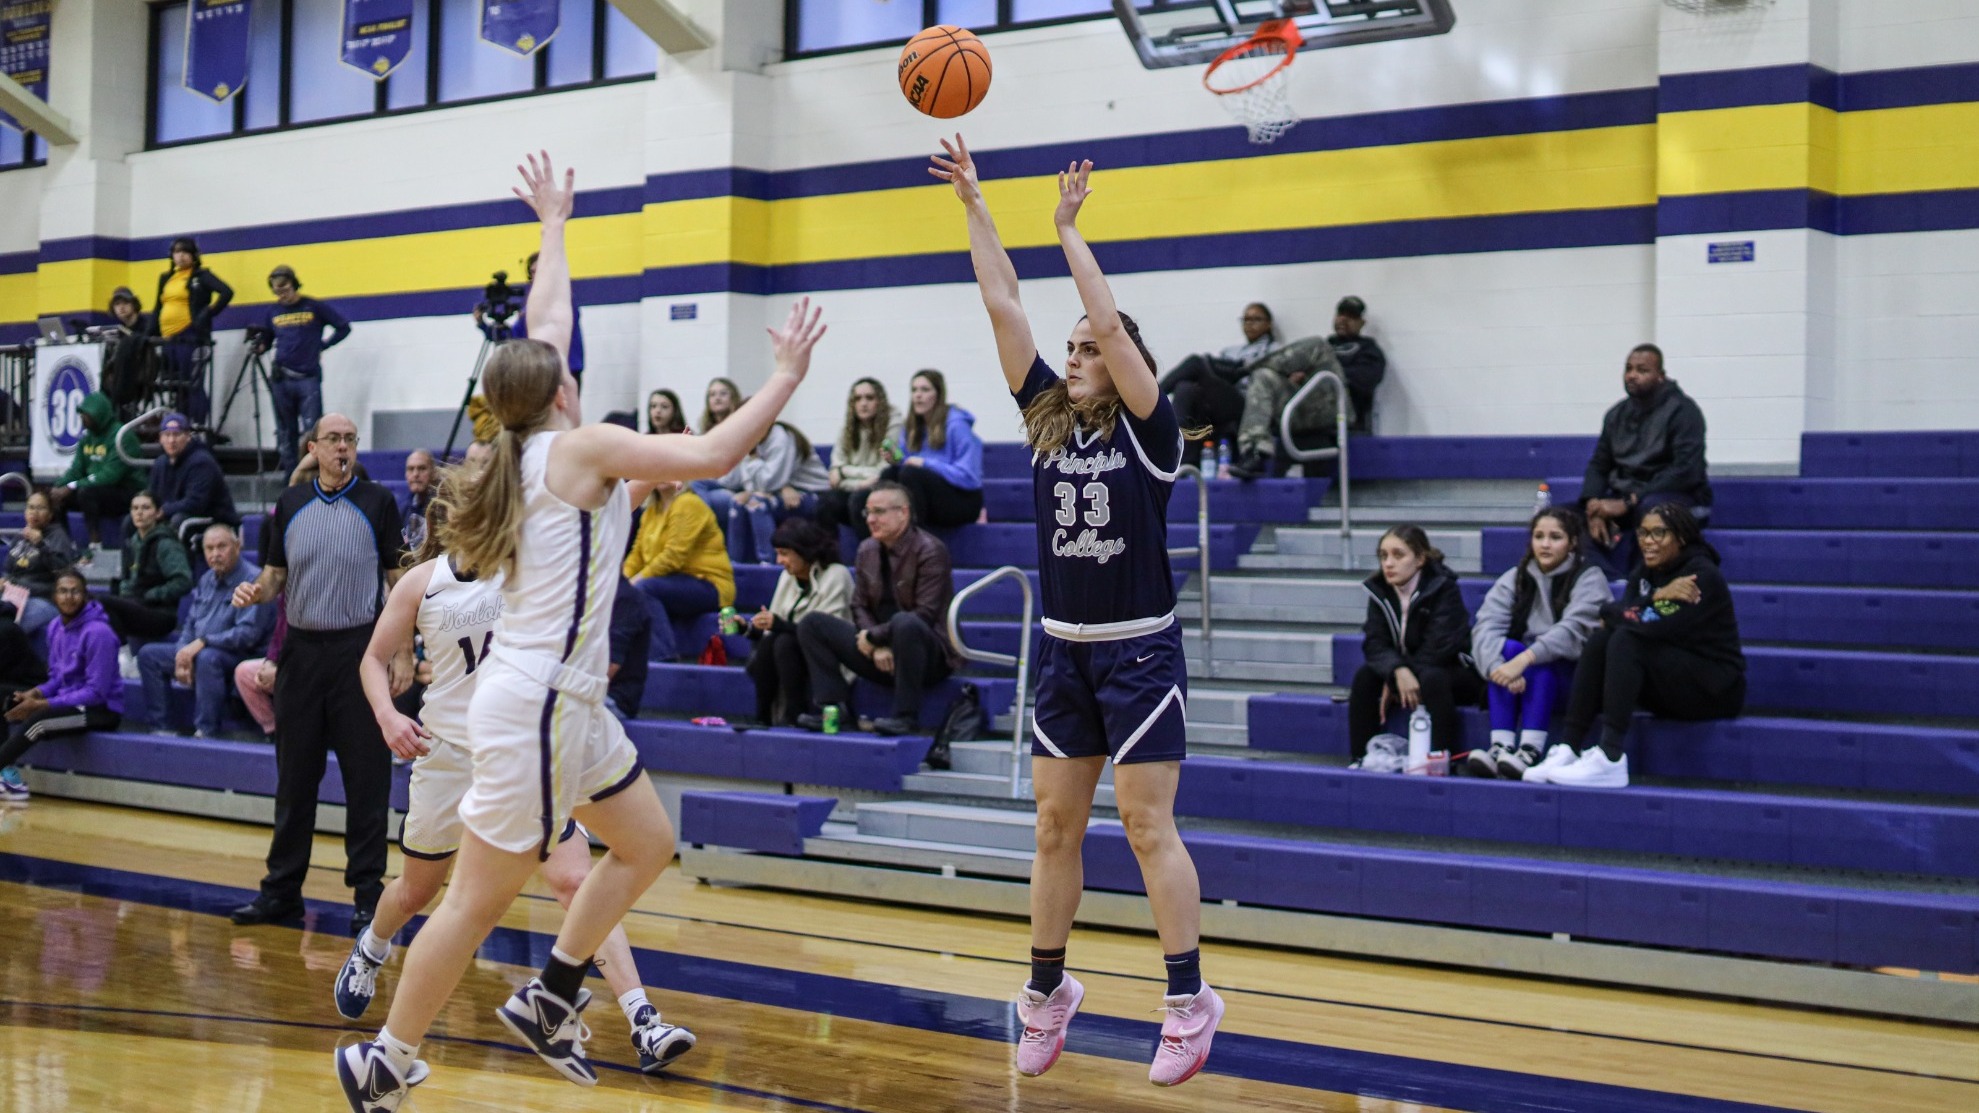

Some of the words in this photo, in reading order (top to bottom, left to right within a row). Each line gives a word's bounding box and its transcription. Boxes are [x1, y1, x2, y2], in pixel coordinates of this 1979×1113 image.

[1043, 446, 1126, 480] Principia
[1053, 481, 1110, 526] 33
[1052, 528, 1125, 564] College
